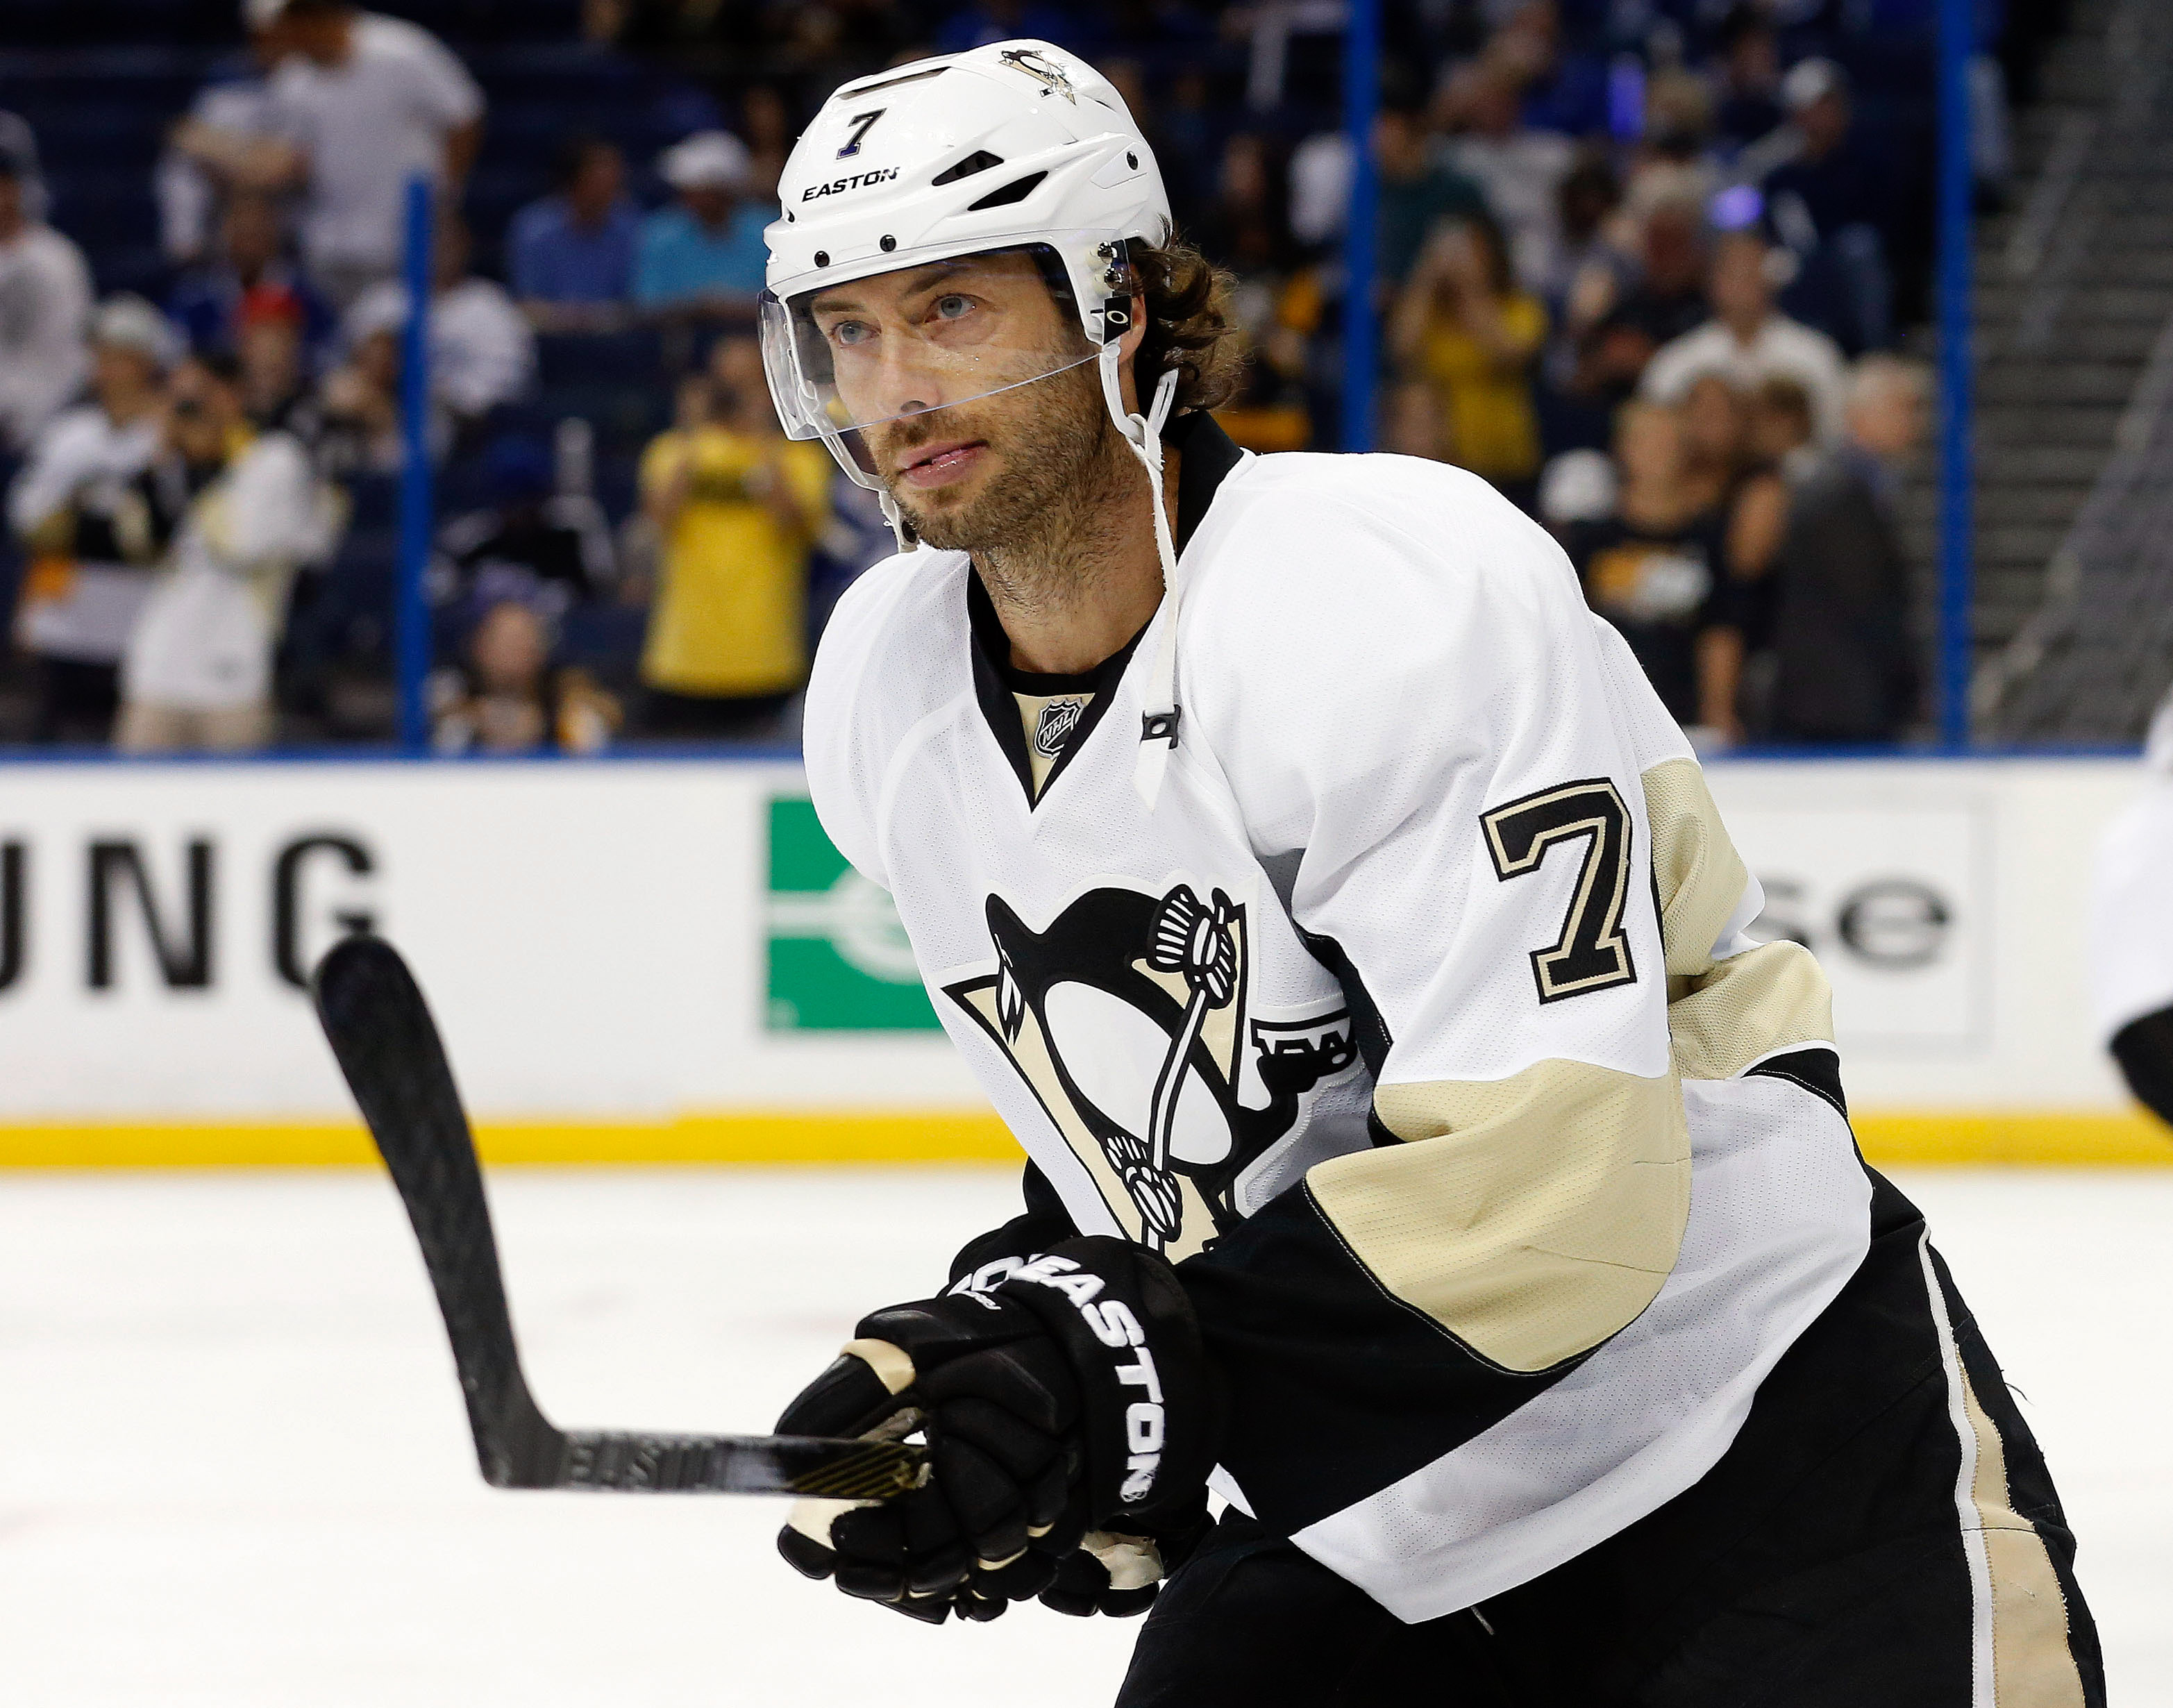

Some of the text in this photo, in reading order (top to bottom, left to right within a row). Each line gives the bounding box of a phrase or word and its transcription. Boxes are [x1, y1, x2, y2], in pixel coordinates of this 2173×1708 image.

[801, 166, 900, 203] EASTON
[836, 108, 888, 160] 7
[1042, 711, 1072, 746] NHL
[0, 832, 378, 996] NG
[1479, 776, 1637, 1005] 7
[1010, 1254, 1165, 1502] EASTON
